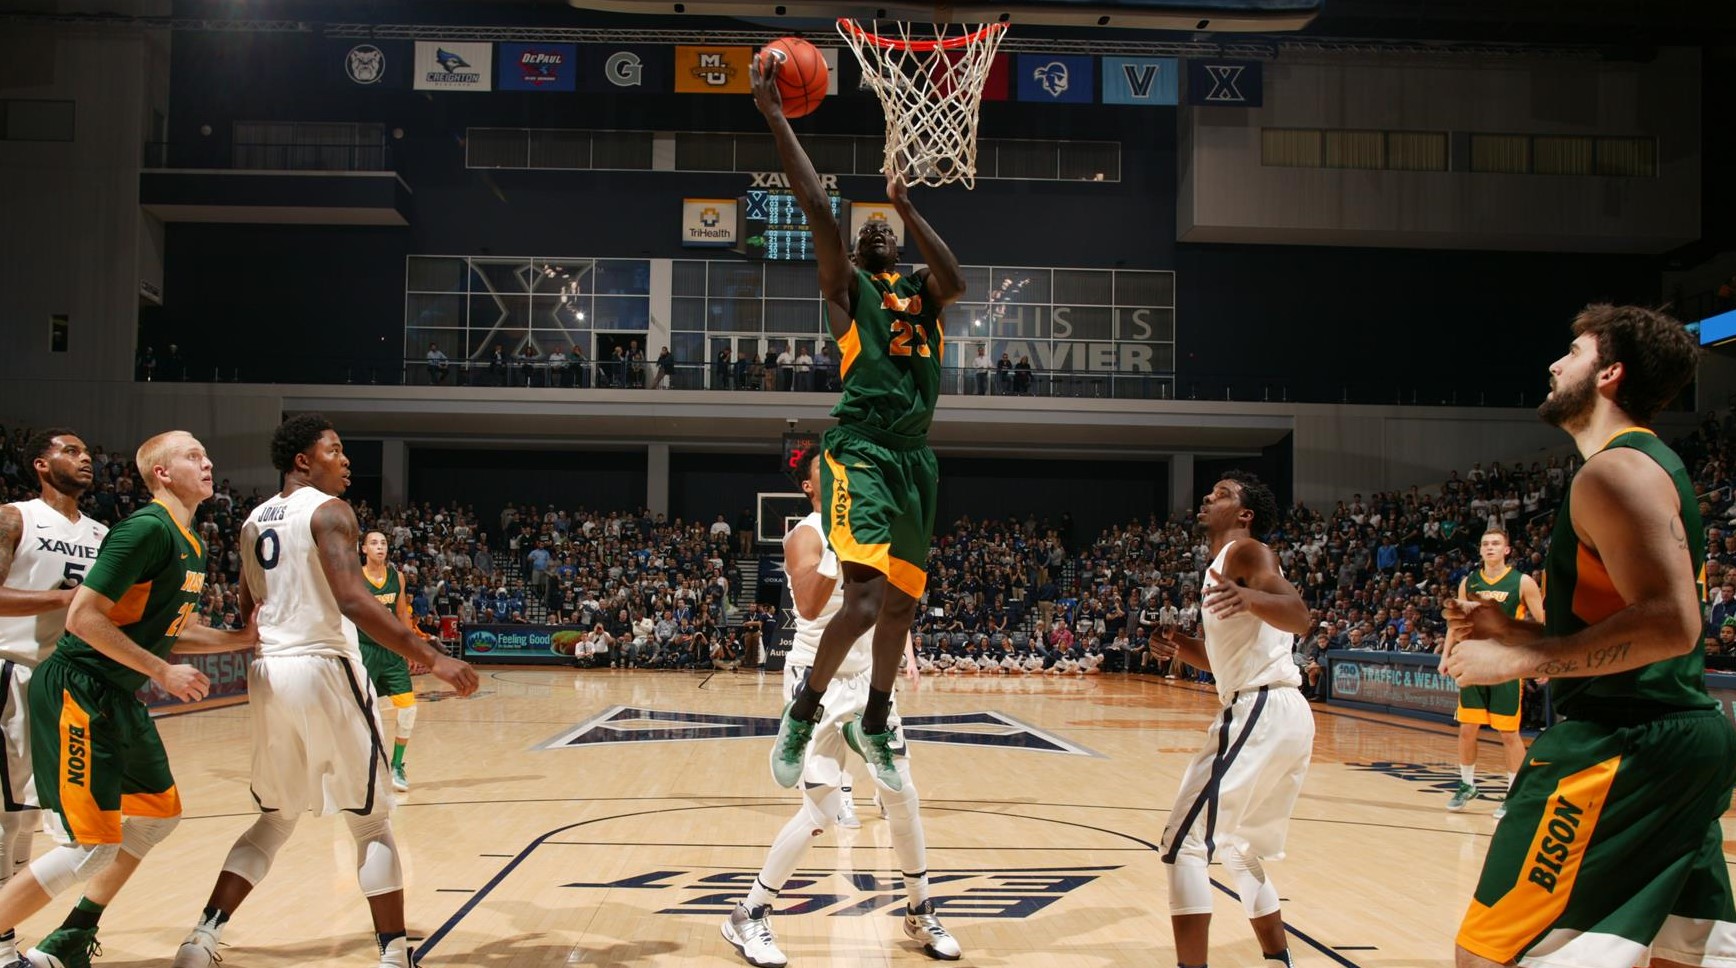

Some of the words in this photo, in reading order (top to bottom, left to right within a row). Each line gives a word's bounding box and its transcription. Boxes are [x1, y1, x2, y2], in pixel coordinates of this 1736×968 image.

[426, 72, 480, 83] CREIGHTON
[605, 51, 642, 87] G
[1122, 64, 1159, 98] V
[1205, 66, 1245, 100] X
[750, 172, 838, 189] XAR
[689, 228, 731, 239] TriHealth
[960, 305, 1073, 338] THIS
[1114, 309, 1152, 340] IS
[990, 341, 1153, 372] AVIER
[258, 505, 288, 522] JONES
[36, 537, 101, 560] XAVIE
[255, 528, 280, 570] 0
[60, 562, 86, 589] 5
[498, 633, 528, 646] Feeling
[529, 633, 550, 645] Good
[1585, 641, 1632, 668] 1997
[1362, 667, 1402, 685] TRAFFIC
[1404, 671, 1412, 687] &
[68, 724, 85, 787] BISON
[1528, 795, 1583, 894] BISON
